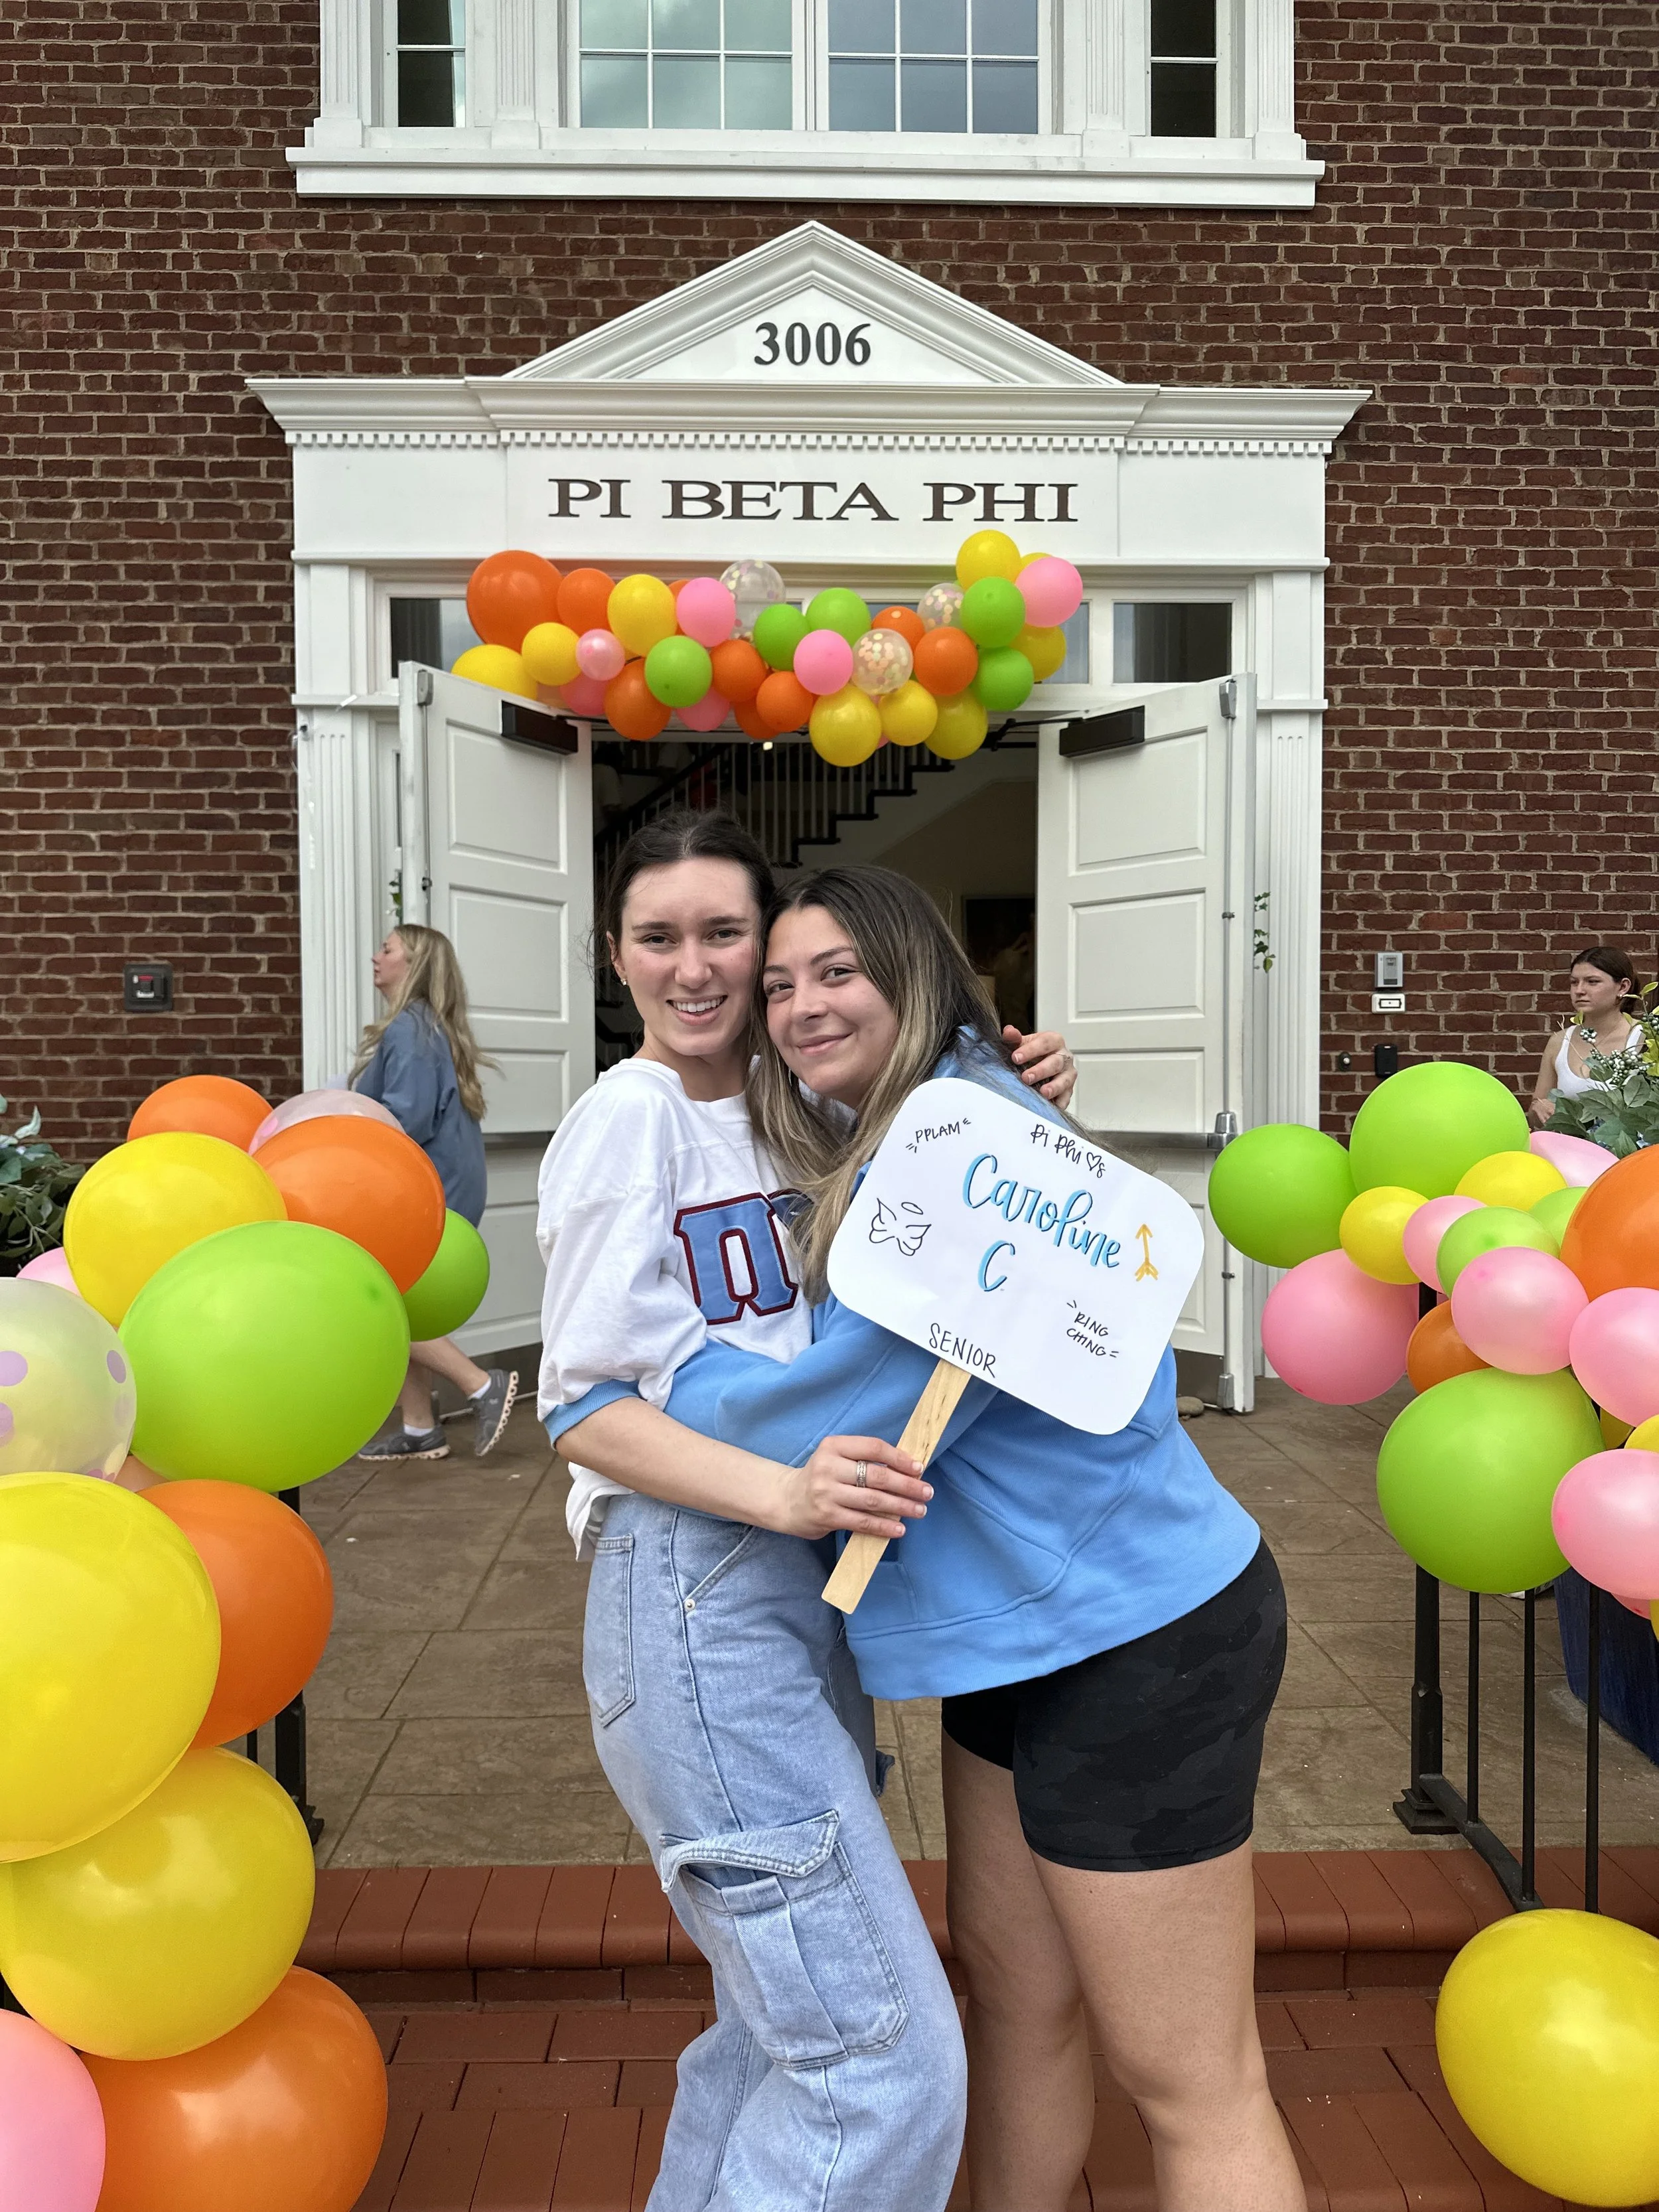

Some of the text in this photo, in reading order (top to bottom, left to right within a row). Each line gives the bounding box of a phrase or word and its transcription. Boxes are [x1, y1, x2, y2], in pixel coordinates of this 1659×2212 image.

[754, 321, 871, 366] 3006
[548, 479, 1078, 522] PI BETA PHI
[915, 1121, 960, 1143] PPLAM
[1031, 1124, 1050, 1147] Pi
[1054, 1134, 1084, 1164] Phi
[962, 1153, 1121, 1268] Caroline
[1066, 1328, 1106, 1356] CHING
[1074, 1311, 1109, 1337] RING
[929, 1323, 996, 1378] SENIOR
